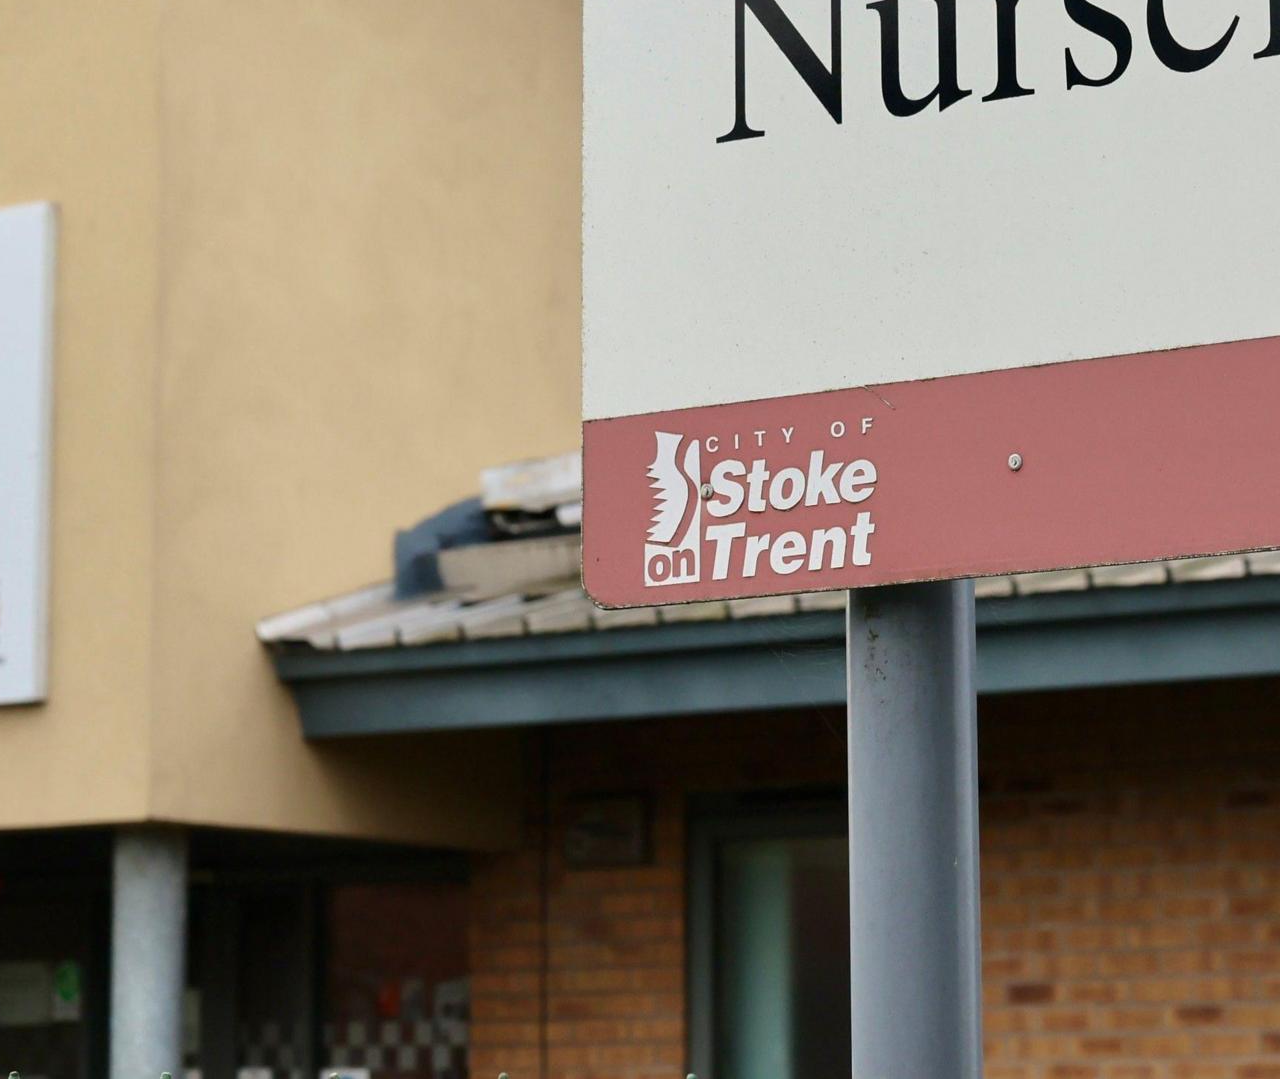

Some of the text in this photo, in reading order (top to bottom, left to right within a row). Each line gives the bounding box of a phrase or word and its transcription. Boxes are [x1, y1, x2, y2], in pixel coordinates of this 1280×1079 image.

[705, 418, 873, 453] CITY OF
[706, 450, 877, 518] Stoke
[647, 511, 876, 583] on Trent
